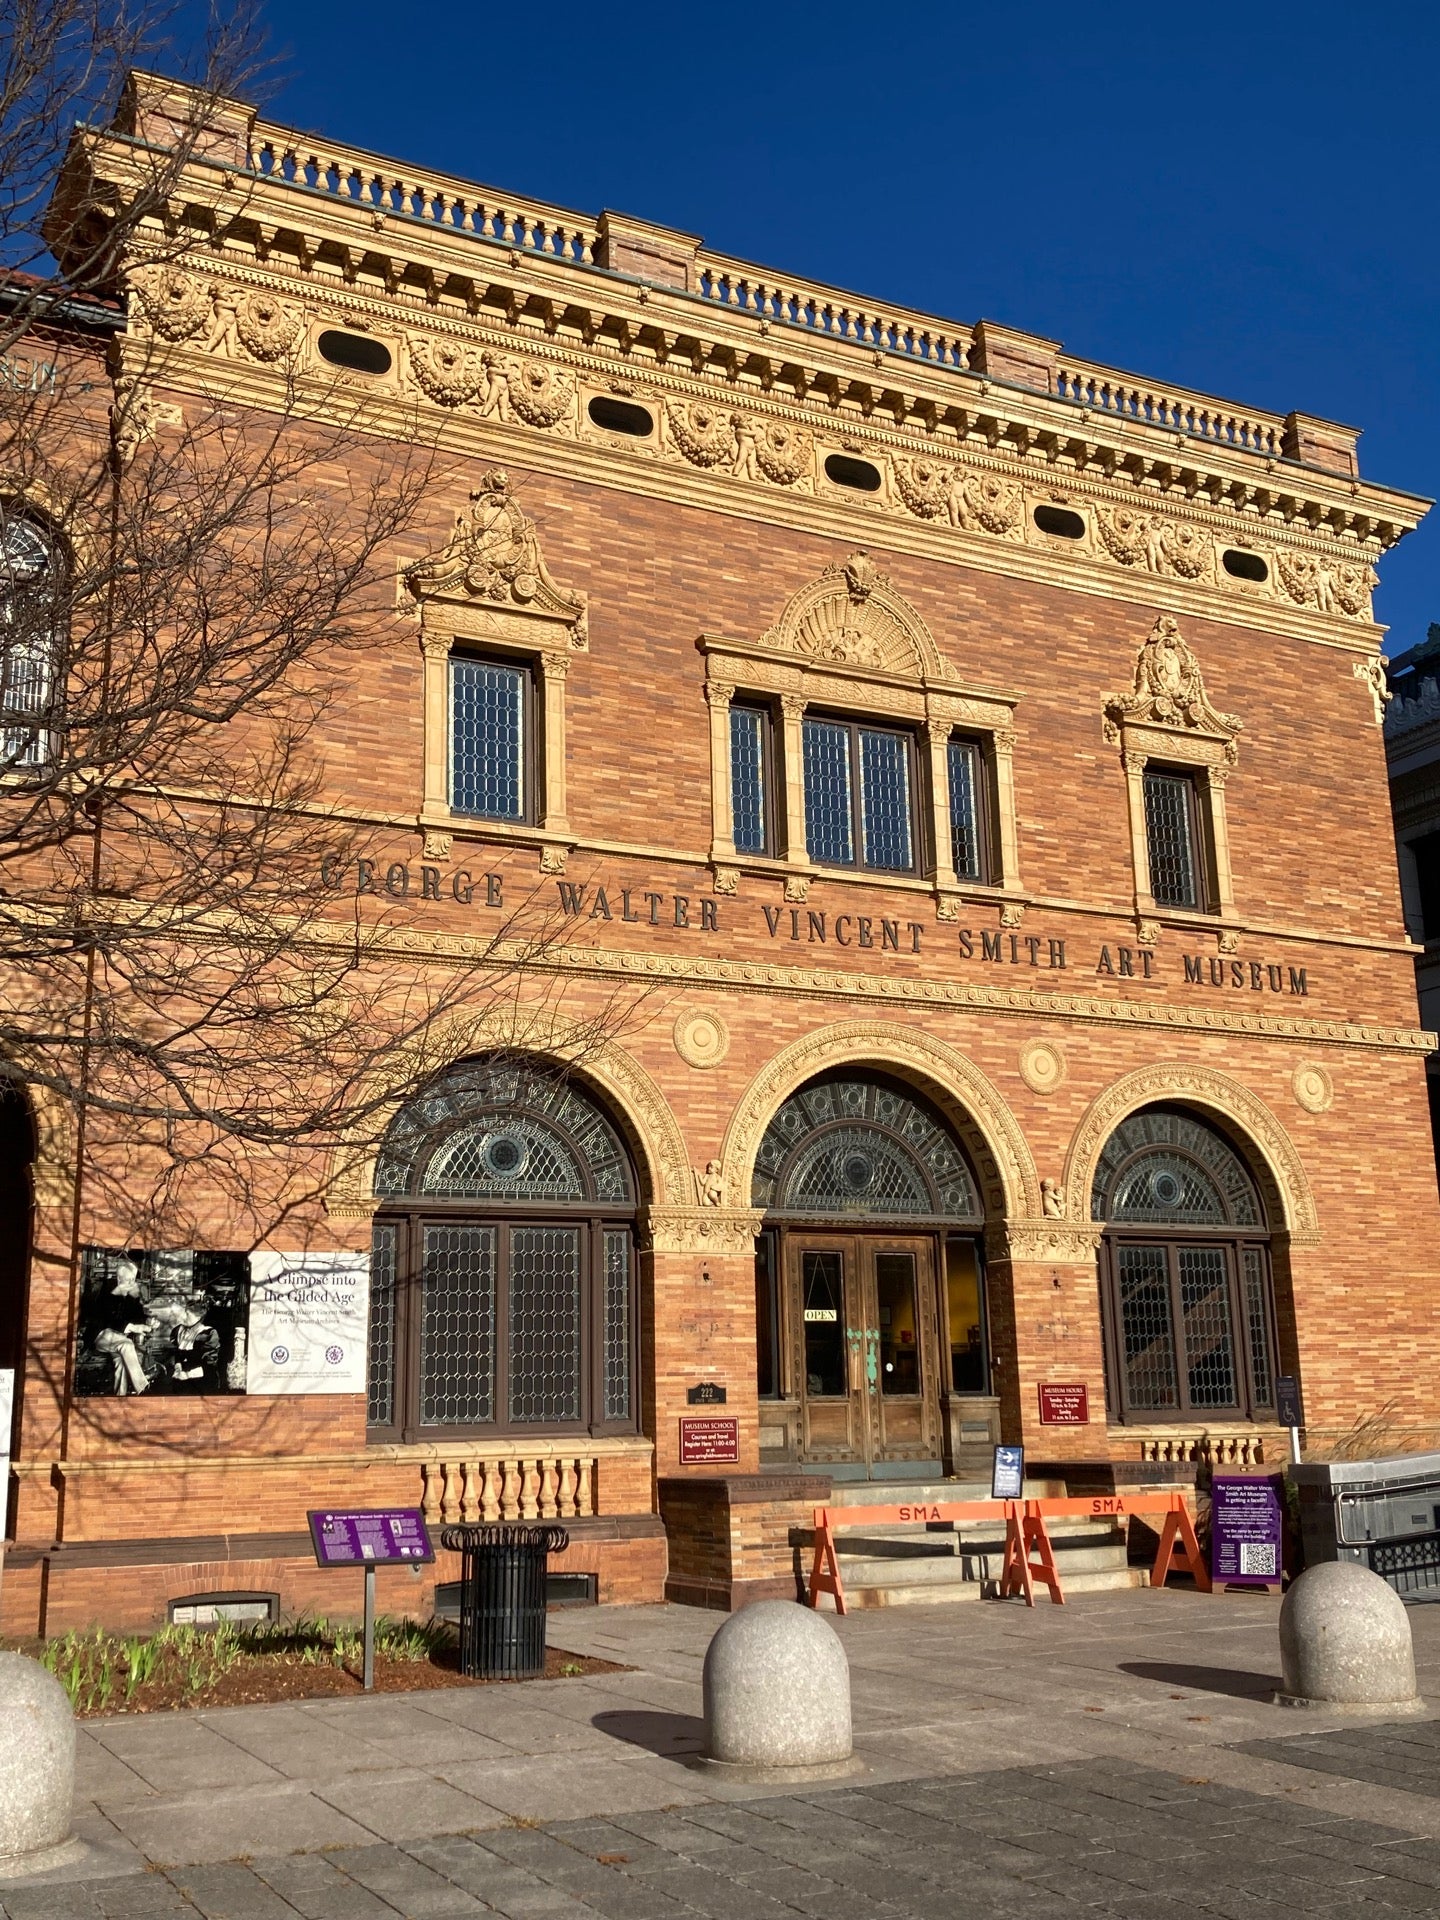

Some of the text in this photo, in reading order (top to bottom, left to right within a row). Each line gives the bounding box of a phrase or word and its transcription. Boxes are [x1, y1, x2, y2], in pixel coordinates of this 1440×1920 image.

[321, 855, 1309, 997] GEORGE WALTER VINCENT SMITH ART MUSEUM
[277, 1271, 329, 1288] Glimpse
[332, 1272, 356, 1286] into
[287, 1290, 328, 1303] Gilded
[332, 1291, 355, 1306] Age
[701, 1387, 714, 1398] 222
[899, 1506, 942, 1521] SMA
[1092, 1499, 1125, 1513] SMA
